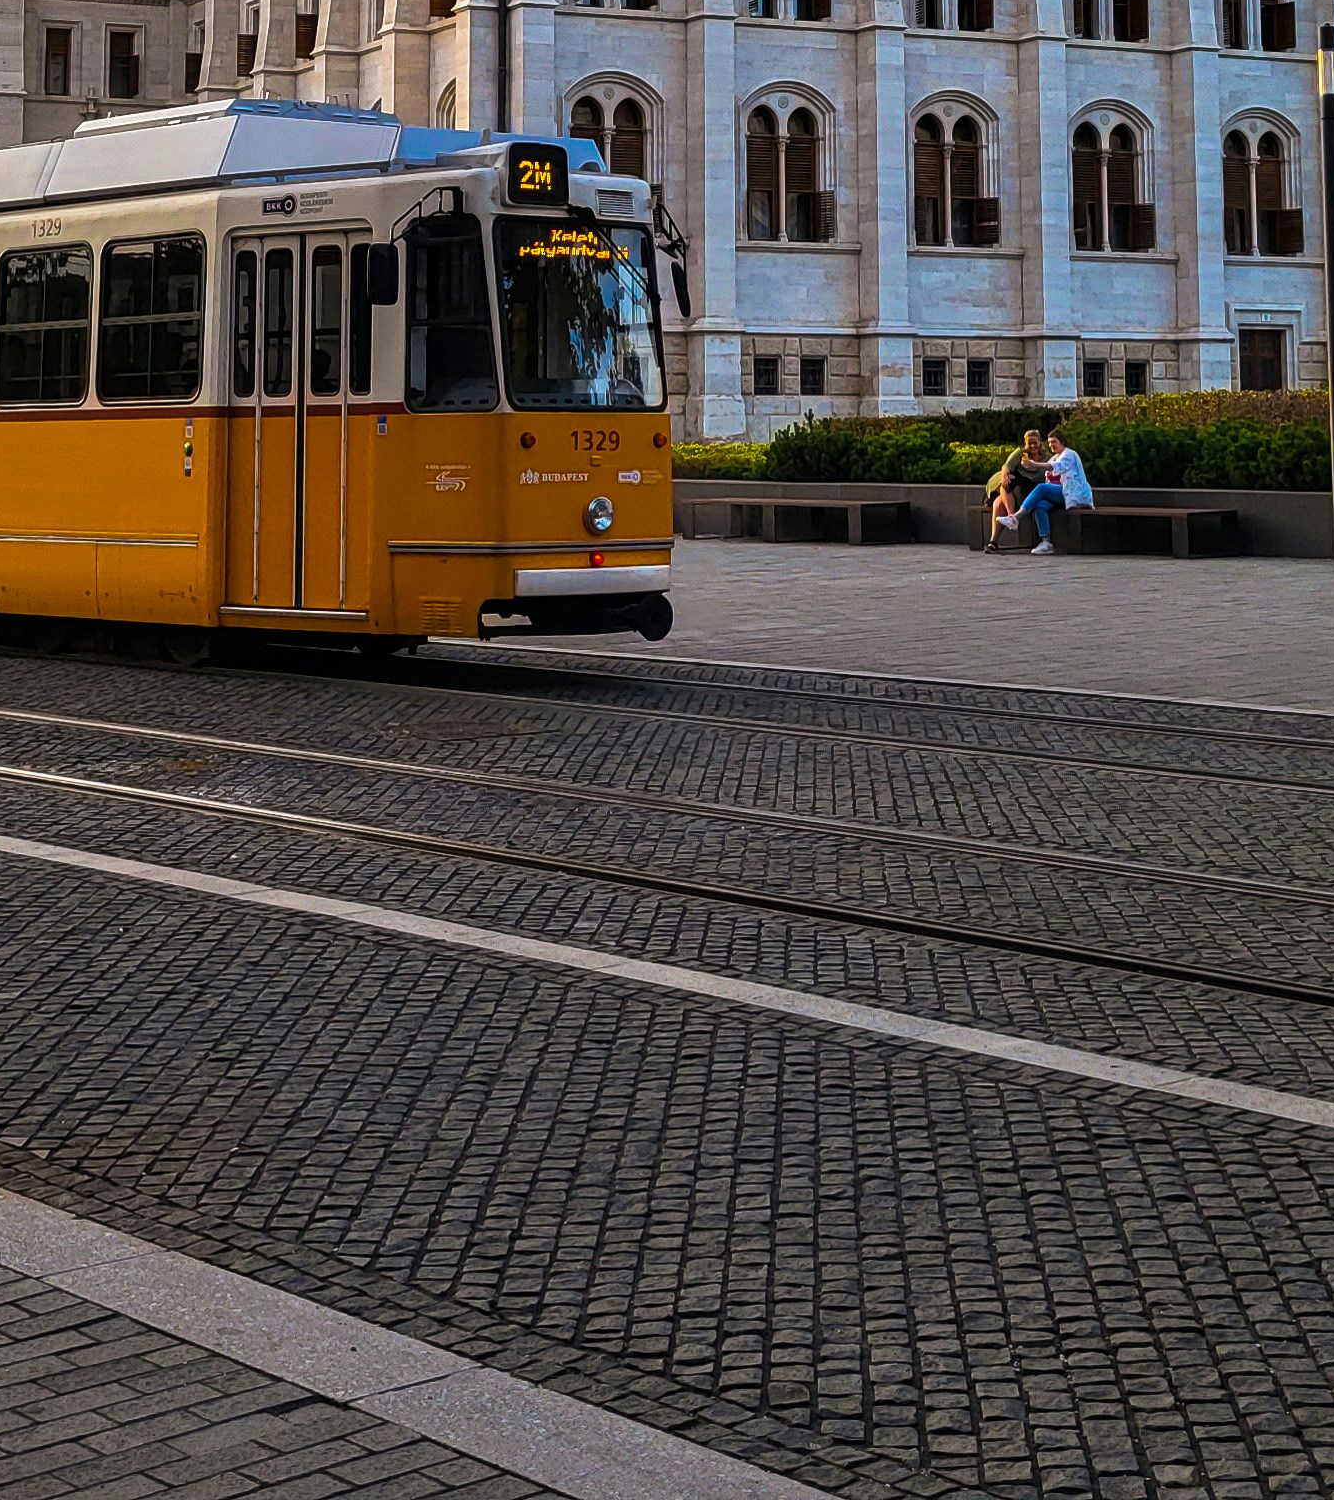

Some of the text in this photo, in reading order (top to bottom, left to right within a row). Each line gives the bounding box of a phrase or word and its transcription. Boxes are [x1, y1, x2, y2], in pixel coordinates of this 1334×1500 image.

[519, 160, 552, 190] 2M
[32, 217, 62, 239] 1329
[570, 430, 620, 451] 1329
[541, 473, 589, 482] BUDAPEST
